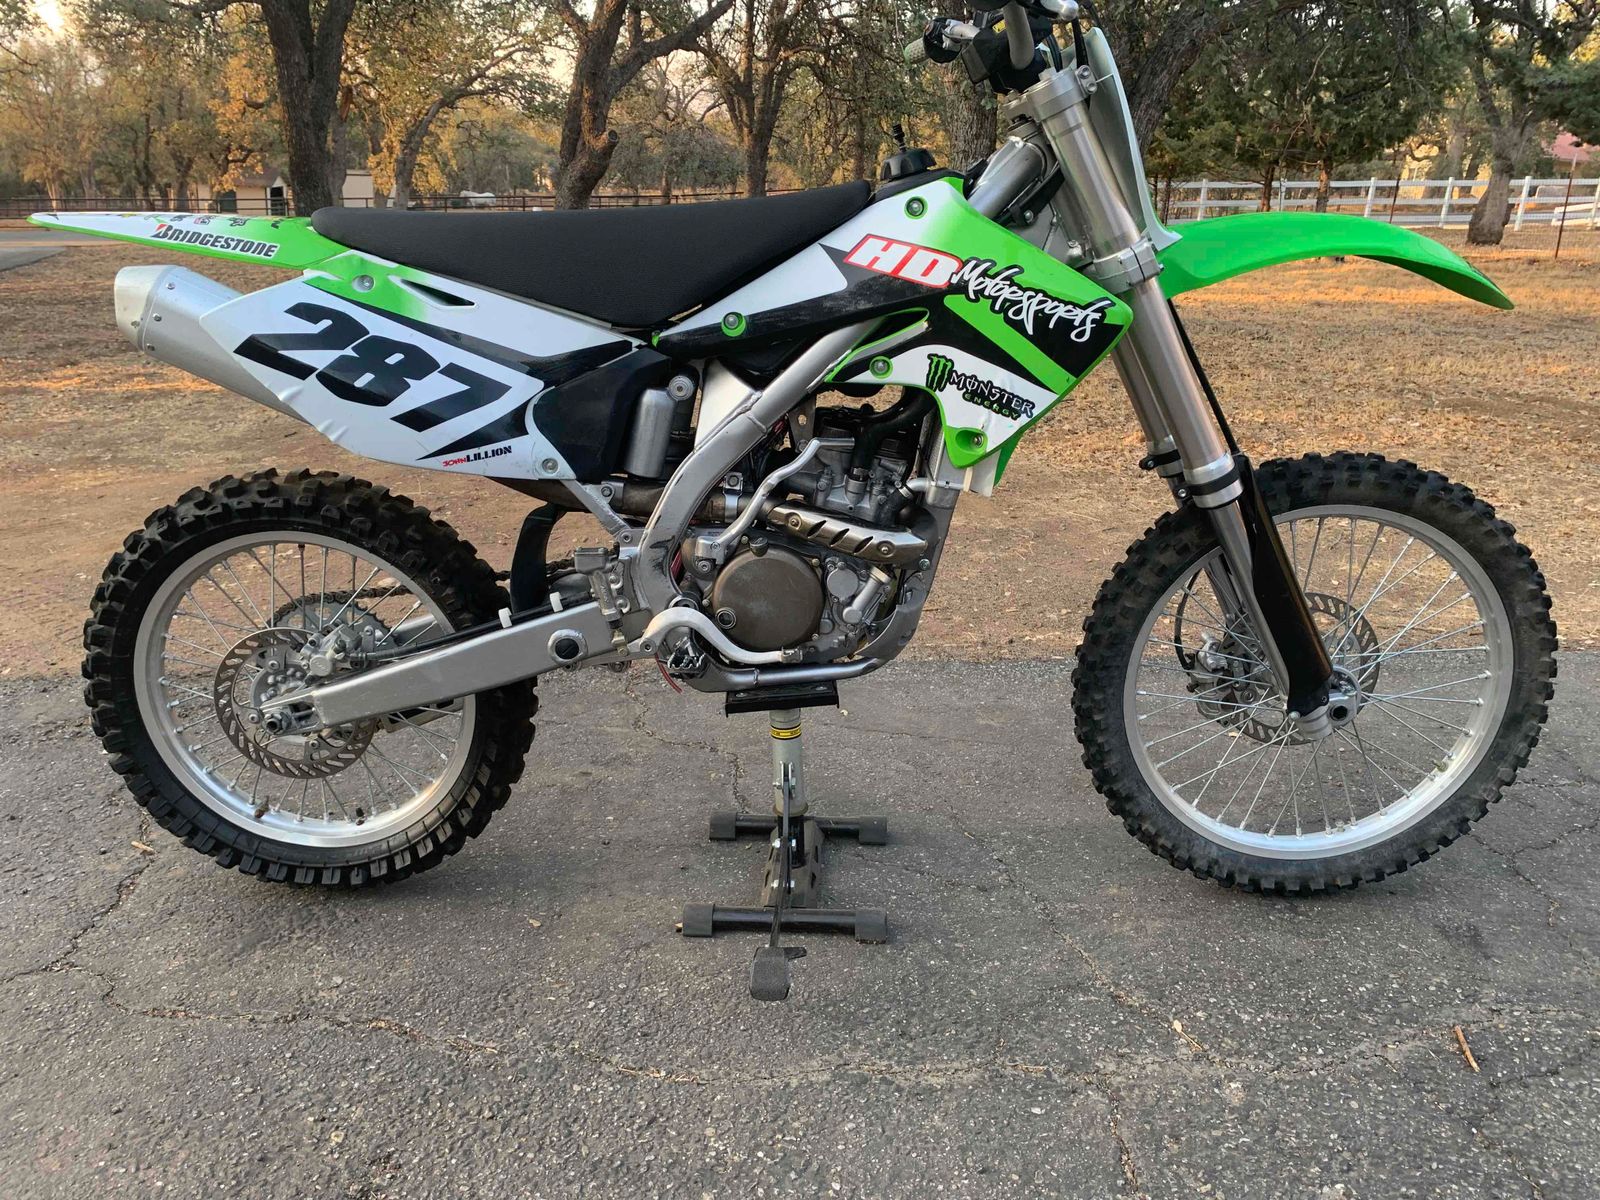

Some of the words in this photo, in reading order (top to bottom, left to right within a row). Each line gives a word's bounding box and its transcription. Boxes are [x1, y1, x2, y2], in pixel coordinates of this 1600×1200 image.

[151, 224, 278, 258] BRIDGESTONE
[846, 236, 962, 287] HD
[950, 259, 1113, 342] Motorsports
[233, 302, 512, 432] 287
[950, 373, 1035, 418] MONSTER
[962, 392, 1021, 420] ENERGY
